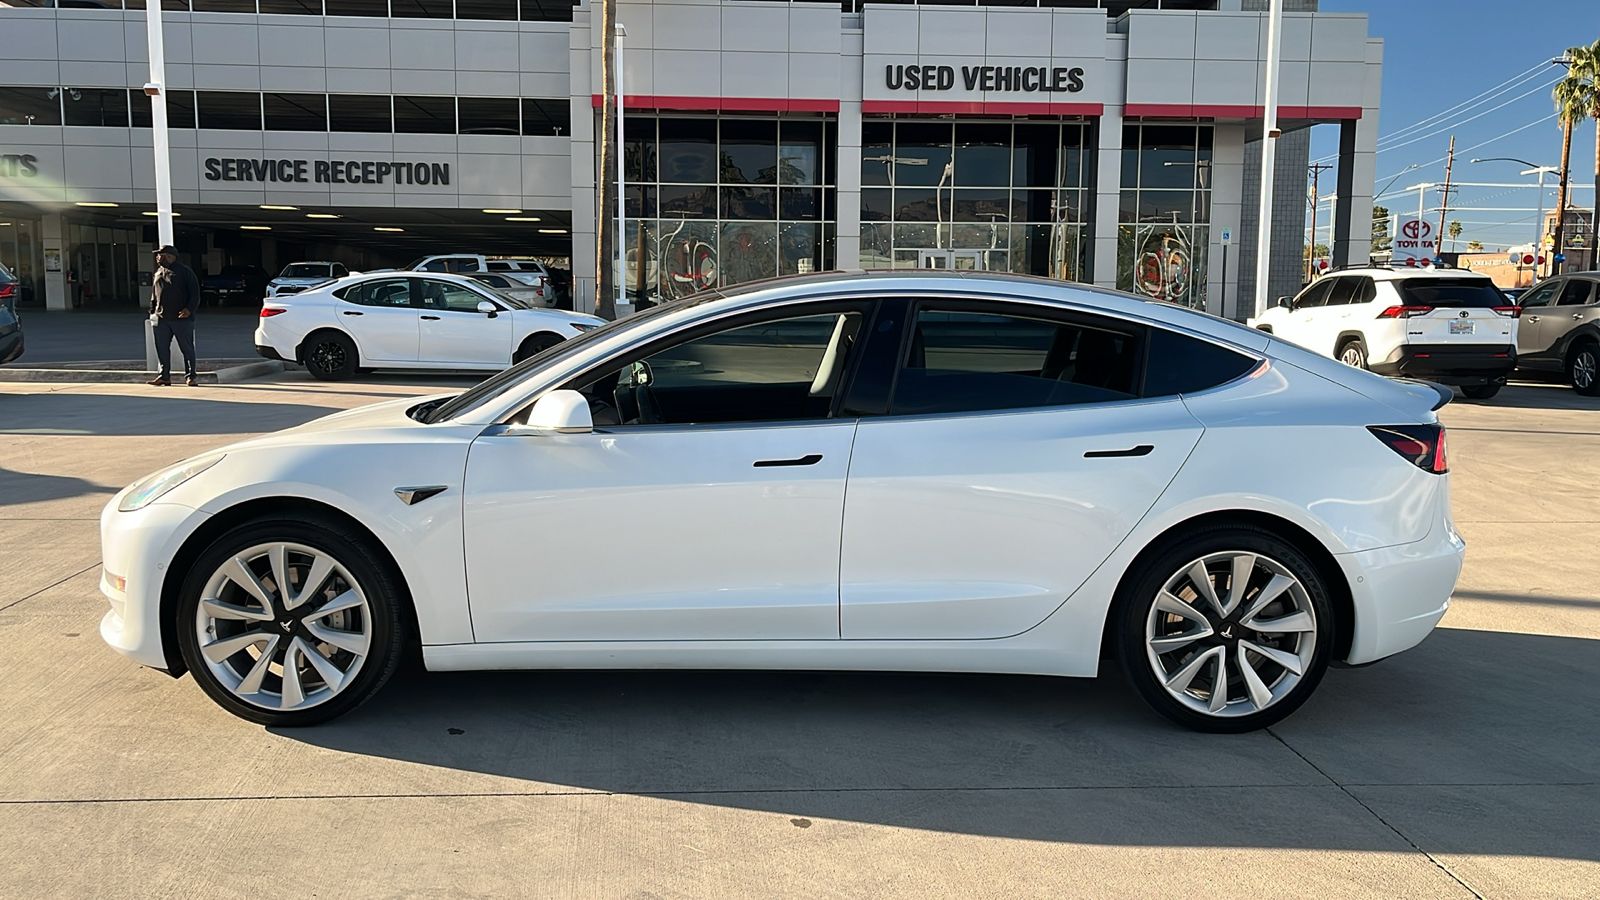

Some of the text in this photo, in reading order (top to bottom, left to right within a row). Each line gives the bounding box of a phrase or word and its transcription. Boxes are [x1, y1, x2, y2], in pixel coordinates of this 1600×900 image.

[886, 65, 1085, 92] USED VEHICLES
[204, 158, 450, 185] SERVICE RECEPTION
